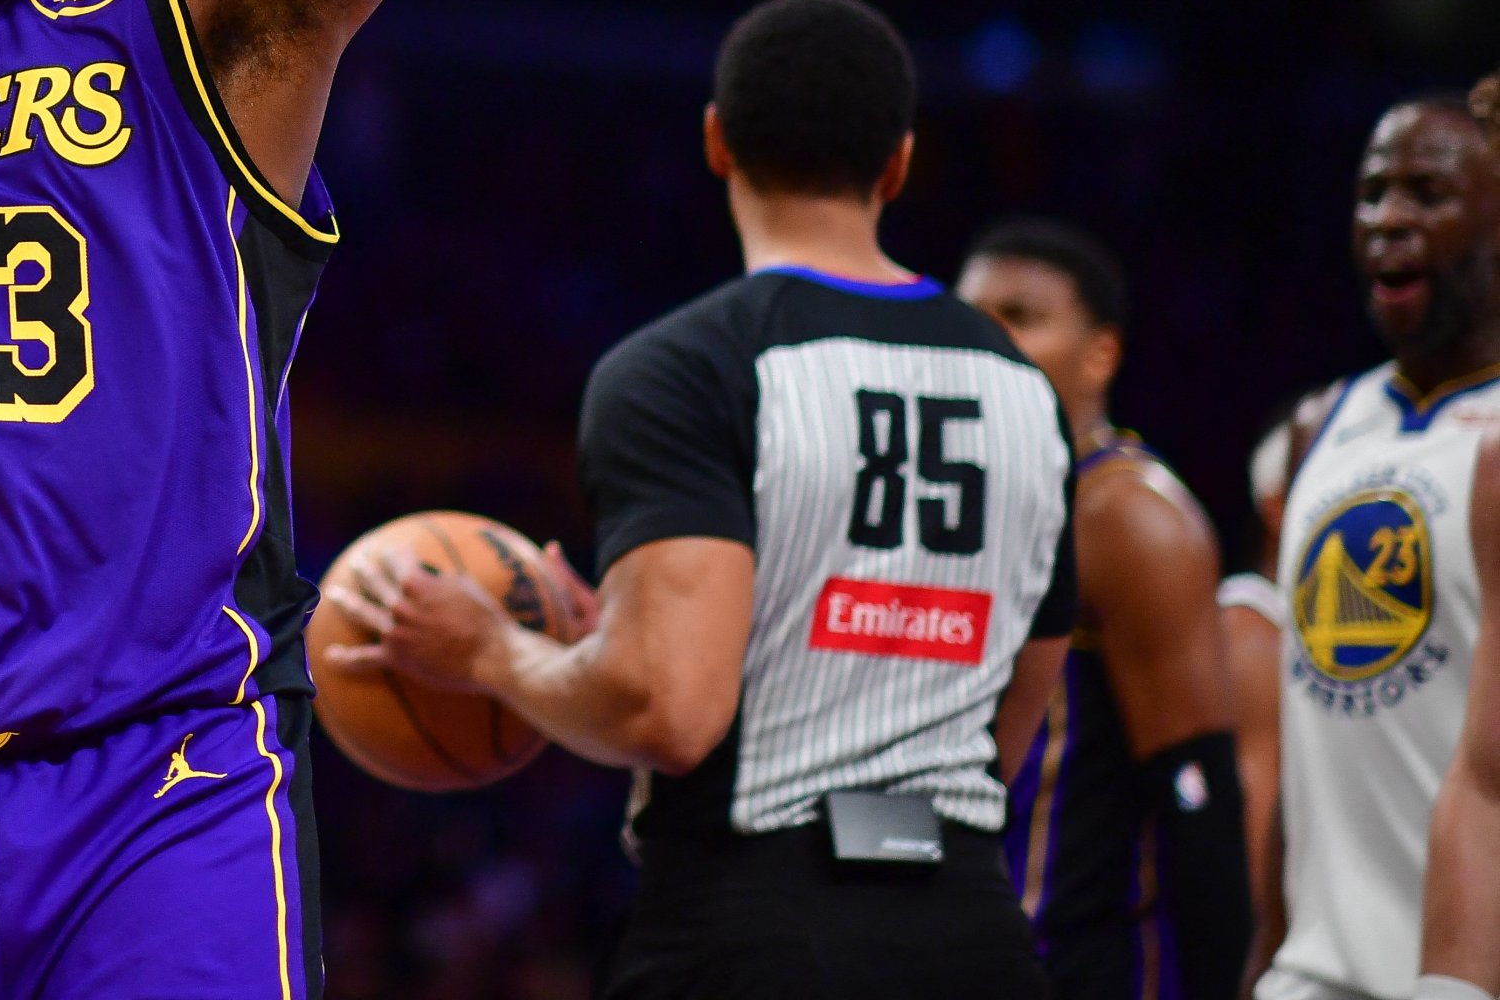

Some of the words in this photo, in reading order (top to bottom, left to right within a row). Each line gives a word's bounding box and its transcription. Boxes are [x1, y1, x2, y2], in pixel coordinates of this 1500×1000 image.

[847, 386, 986, 557] 85
[1364, 526, 1418, 586] 23
[825, 591, 975, 646] Emirates
